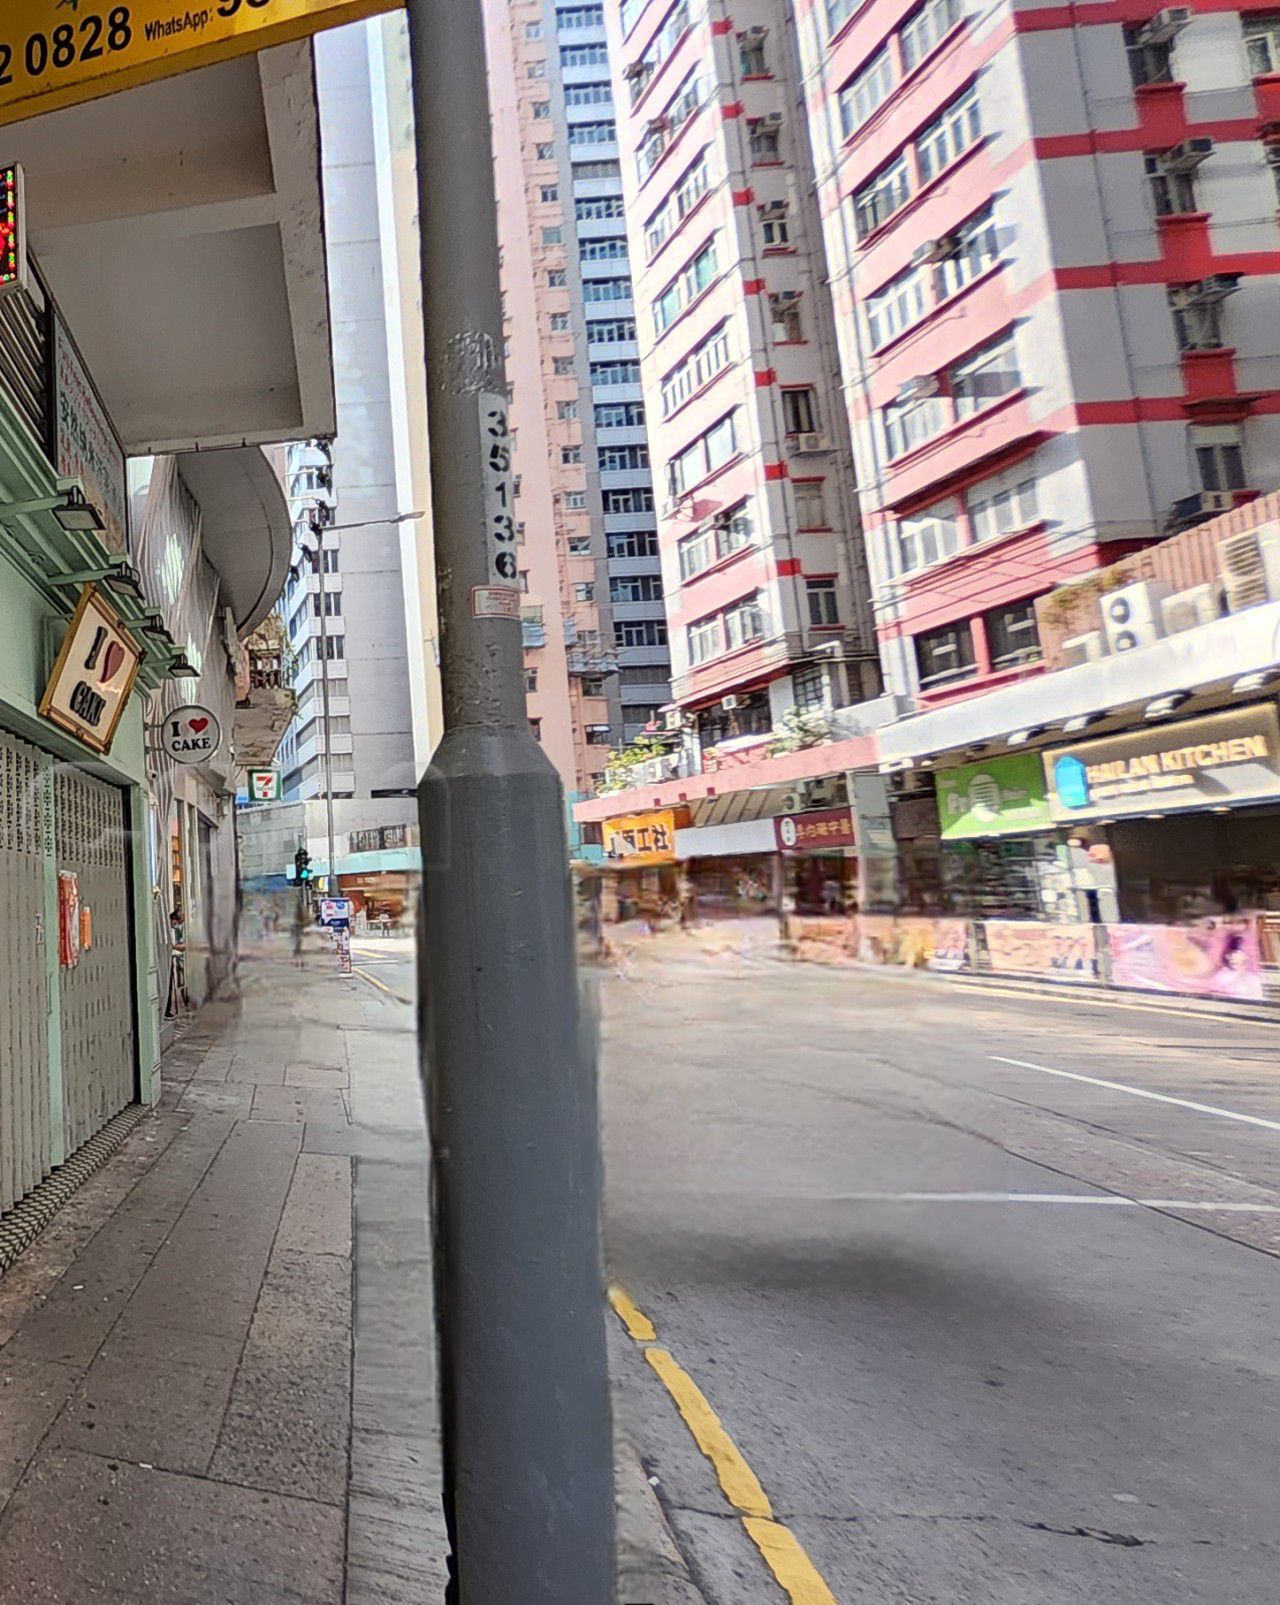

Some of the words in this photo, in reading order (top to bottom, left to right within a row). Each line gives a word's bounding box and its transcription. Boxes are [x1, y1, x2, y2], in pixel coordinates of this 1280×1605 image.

[24, 6, 133, 77] 0828
[144, 8, 213, 42] WhatsApp:
[171, 721, 180, 738] I
[171, 737, 211, 752] CAKE
[1160, 735, 1269, 772] KITCHEN
